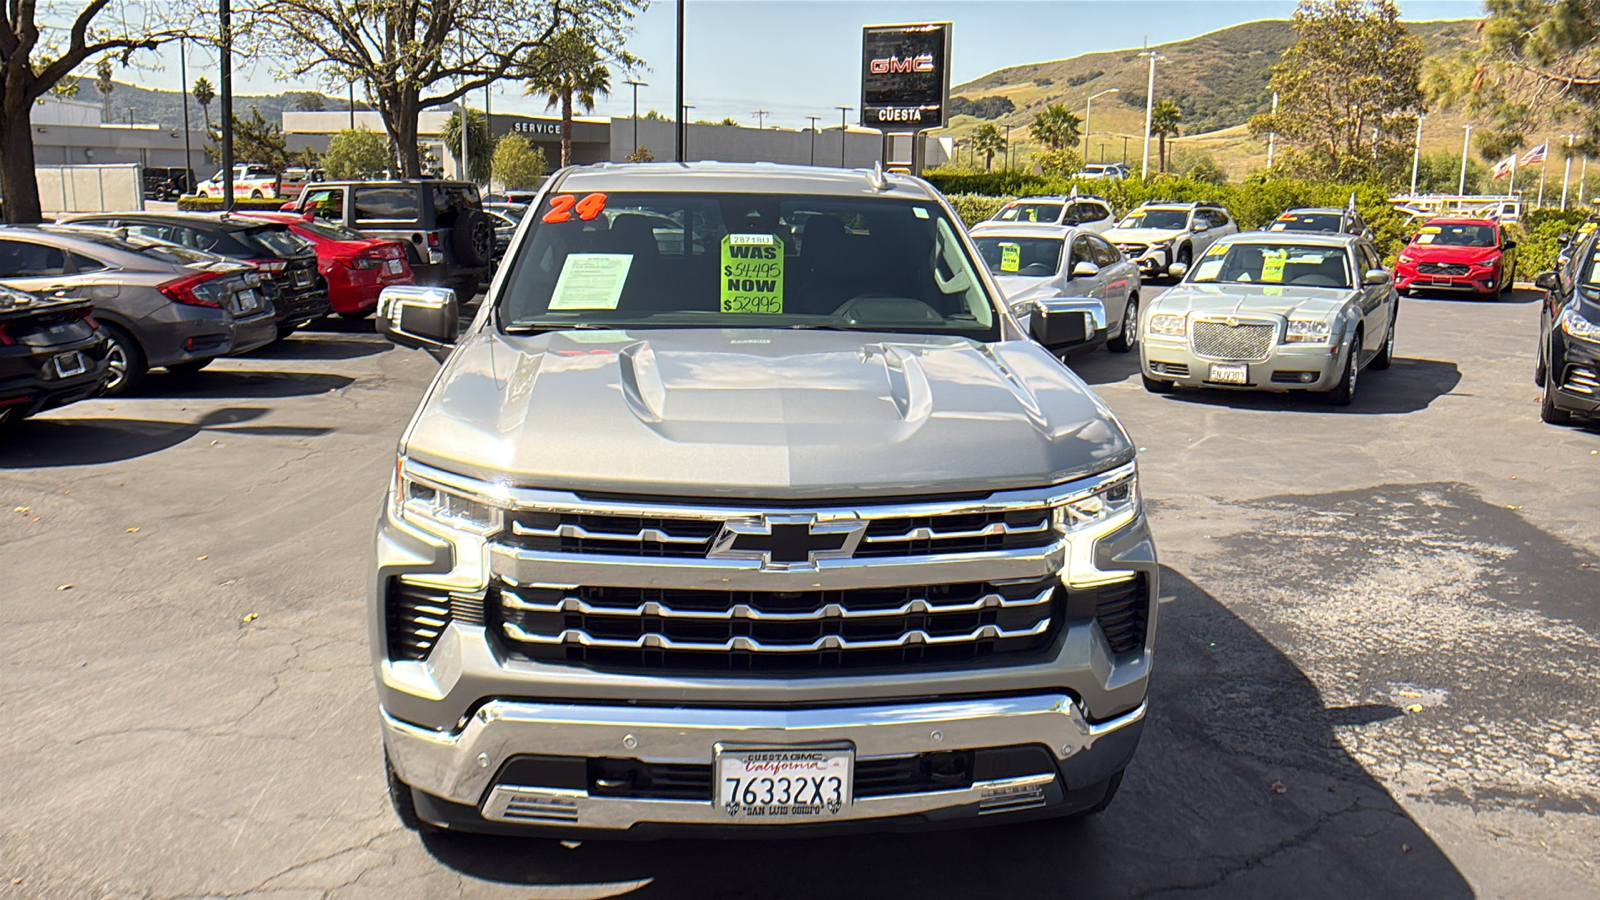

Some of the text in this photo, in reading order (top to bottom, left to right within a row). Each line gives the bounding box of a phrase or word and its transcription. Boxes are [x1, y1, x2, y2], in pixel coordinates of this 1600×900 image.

[870, 56, 934, 74] GMC
[878, 109, 922, 122] CUESTA
[514, 122, 561, 134] SERVICE
[542, 193, 607, 223] 24
[729, 246, 777, 260] WAS
[727, 279, 777, 293] NOW
[747, 753, 823, 762] CUESTA GMC
[745, 760, 828, 776] California
[725, 776, 842, 805] 76332X3
[746, 804, 821, 816] SAN LUIS OBISPO
